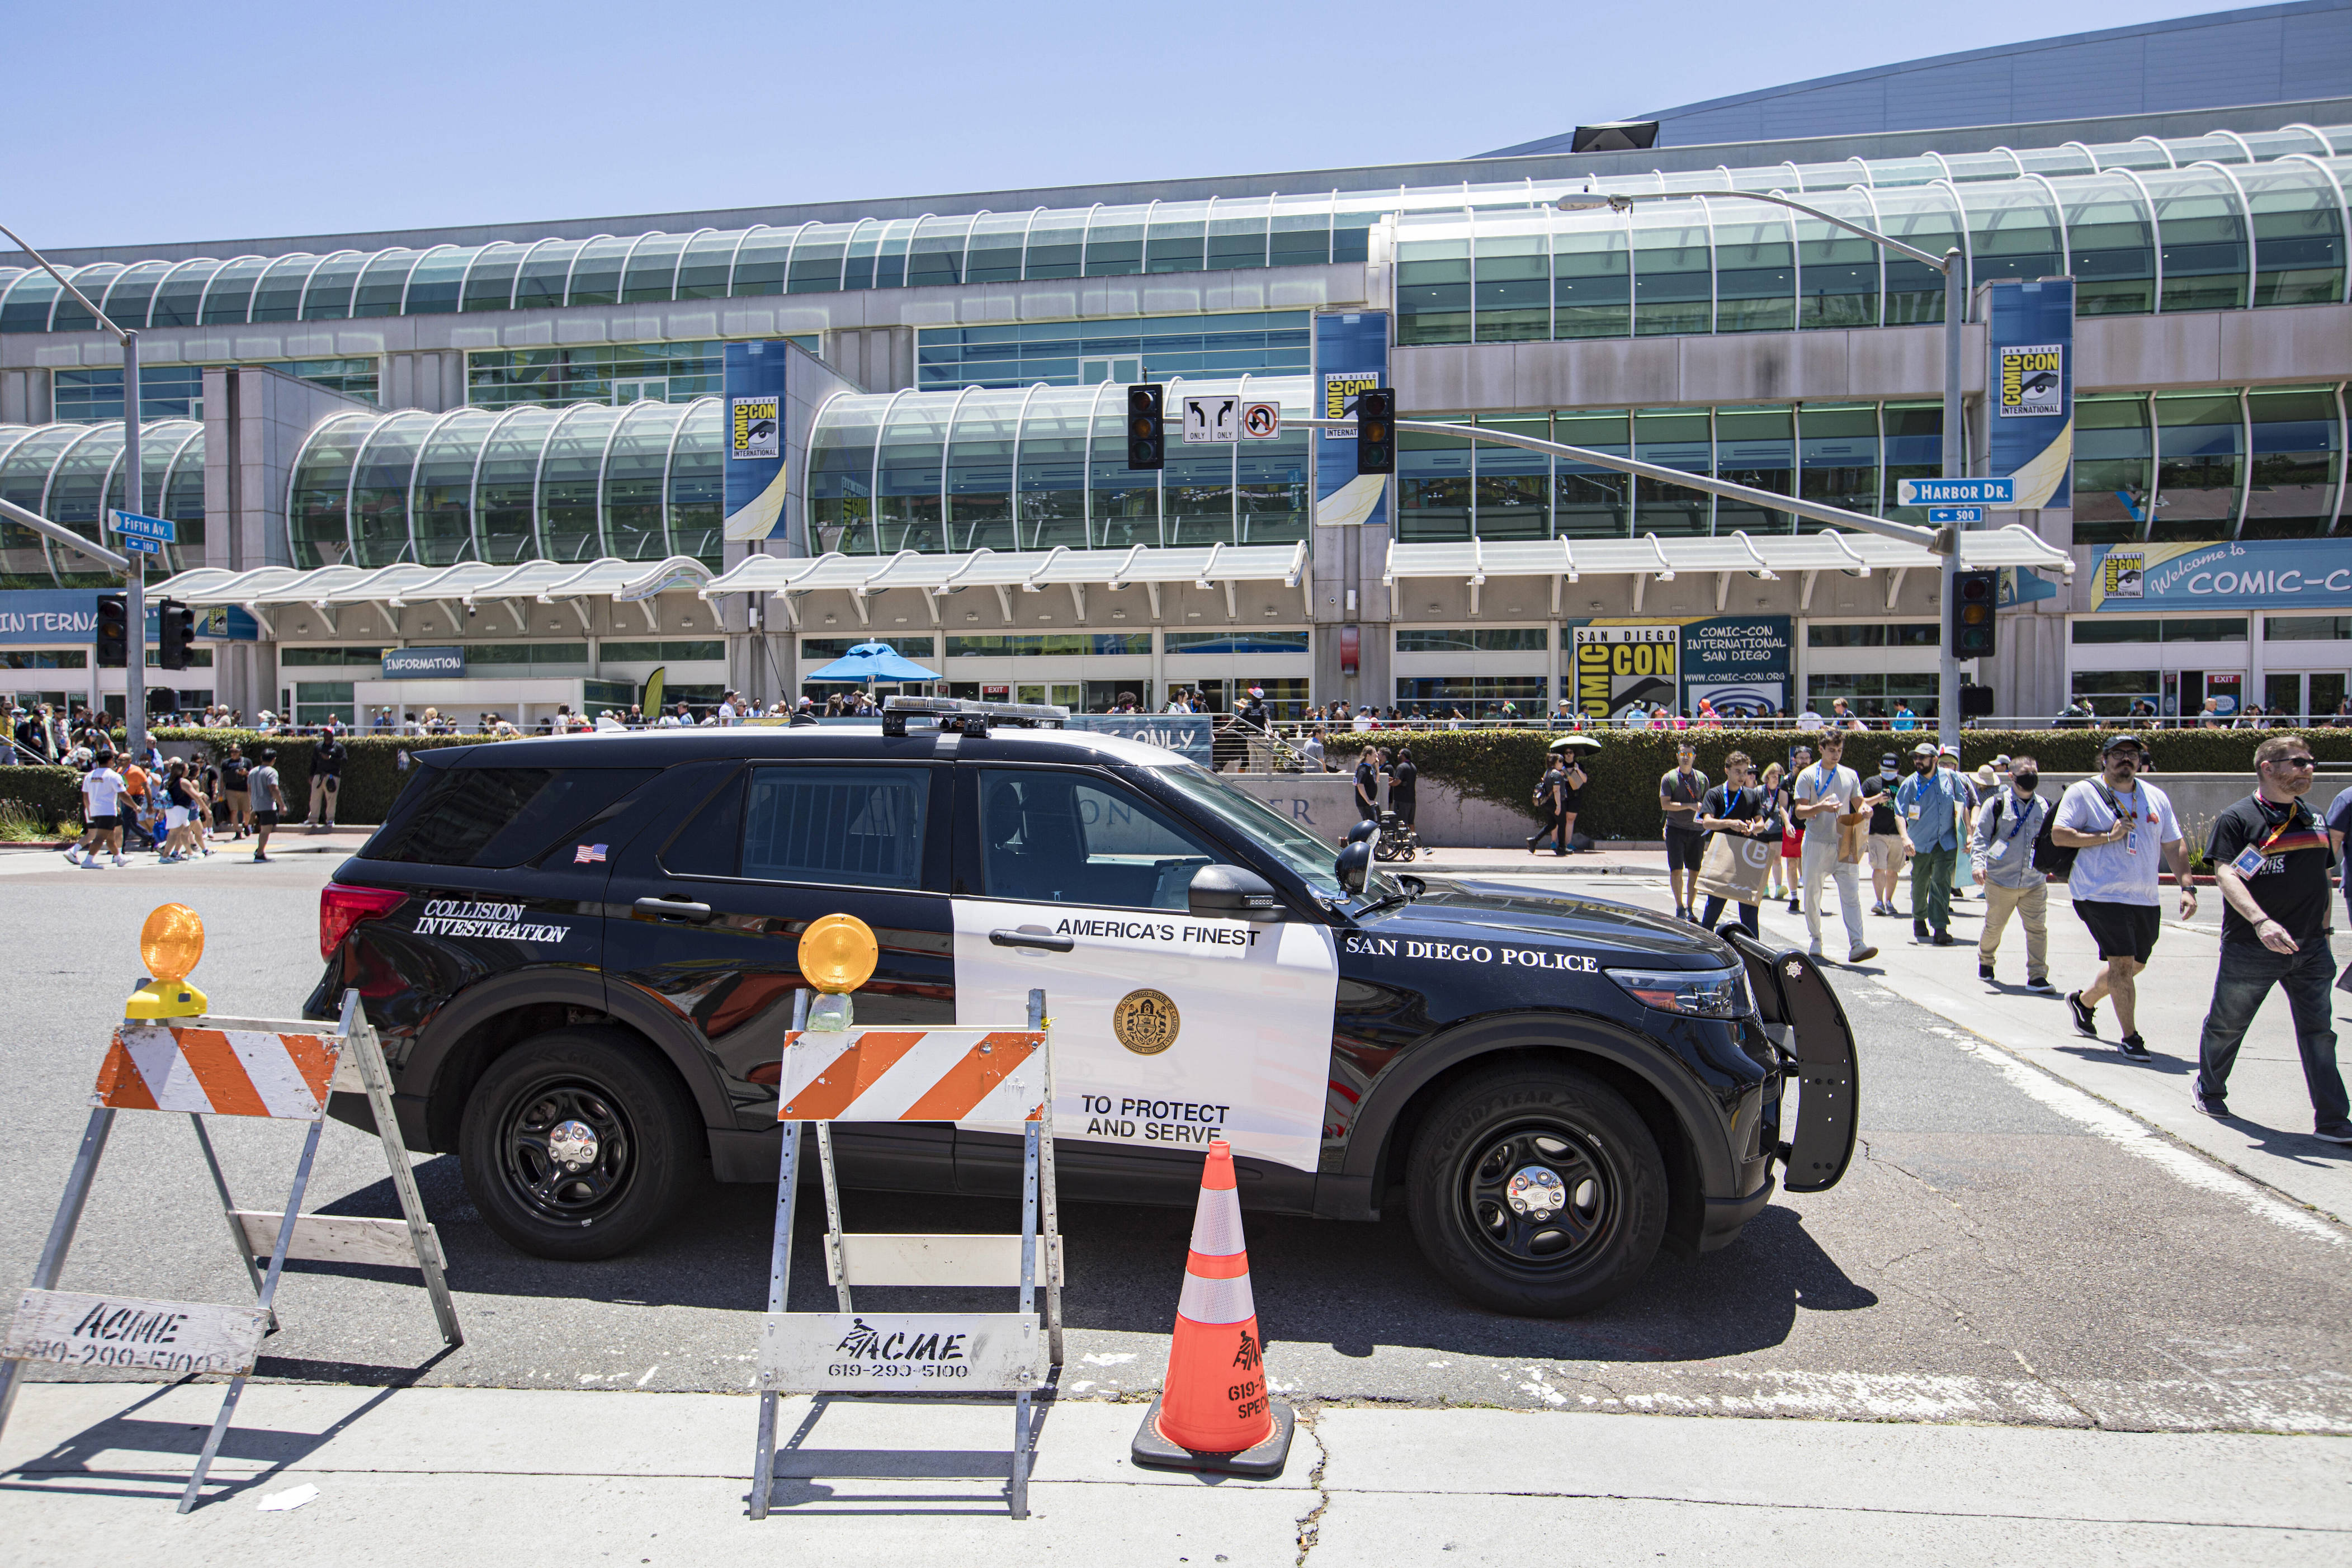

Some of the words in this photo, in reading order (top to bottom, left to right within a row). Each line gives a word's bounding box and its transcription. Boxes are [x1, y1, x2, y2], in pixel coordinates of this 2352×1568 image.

[2023, 353, 2058, 371] CON
[2003, 355, 2022, 405] COMIC
[1328, 381, 1344, 419] OMIC
[2002, 405, 2058, 414] INTERNATIONAL
[749, 404, 776, 419] CON
[735, 405, 749, 450] COMIC
[1327, 428, 1358, 437] INTERNAT
[1921, 484, 1978, 500] HARBOR
[1984, 483, 2009, 499] DR.
[1956, 511, 1975, 521] 500
[125, 517, 150, 533] FIFTH
[152, 522, 167, 537] AV.
[143, 542, 154, 551] 100
[2118, 559, 2141, 570] CON
[2151, 550, 2226, 594] Welcome
[2230, 542, 2246, 556] to
[2106, 559, 2118, 592] COMIC
[1578, 631, 1608, 642] SAN
[1624, 630, 1676, 641] DIEGO
[1699, 625, 1773, 637] COMIC-CON
[1687, 637, 1787, 650] INTERNATIONAL
[386, 657, 461, 671] INFORMATION
[1613, 644, 1674, 676] CON
[1702, 651, 1726, 662] SAN
[1732, 650, 1771, 662] DIEGO
[1684, 672, 1786, 682] WWW.COMIC-CON.ORG
[1132, 729, 1195, 750] ONLY
[2261, 858, 2285, 871] VHS
[424, 899, 526, 921] COLLISION
[413, 917, 570, 943] INVESTIGATION
[1056, 919, 1174, 941] AMERICA'S
[1183, 926, 1260, 946] FINEST
[1346, 937, 1399, 957] SAN
[1406, 941, 1493, 963] DIEGO
[1501, 948, 1599, 974] POLICE
[1122, 996, 1132, 1007] SAN
[1151, 992, 1167, 1003] STATE
[1166, 1011, 1177, 1043] CALIFORNIA
[1127, 1042, 1142, 1052] SEMPER
[1081, 1094, 1112, 1114] TO
[1121, 1098, 1230, 1124] PROTECT
[1087, 1118, 1136, 1139] AND
[1144, 1122, 1221, 1144] SERVE
[74, 1302, 188, 1344] ACME
[854, 1331, 966, 1360] ACME
